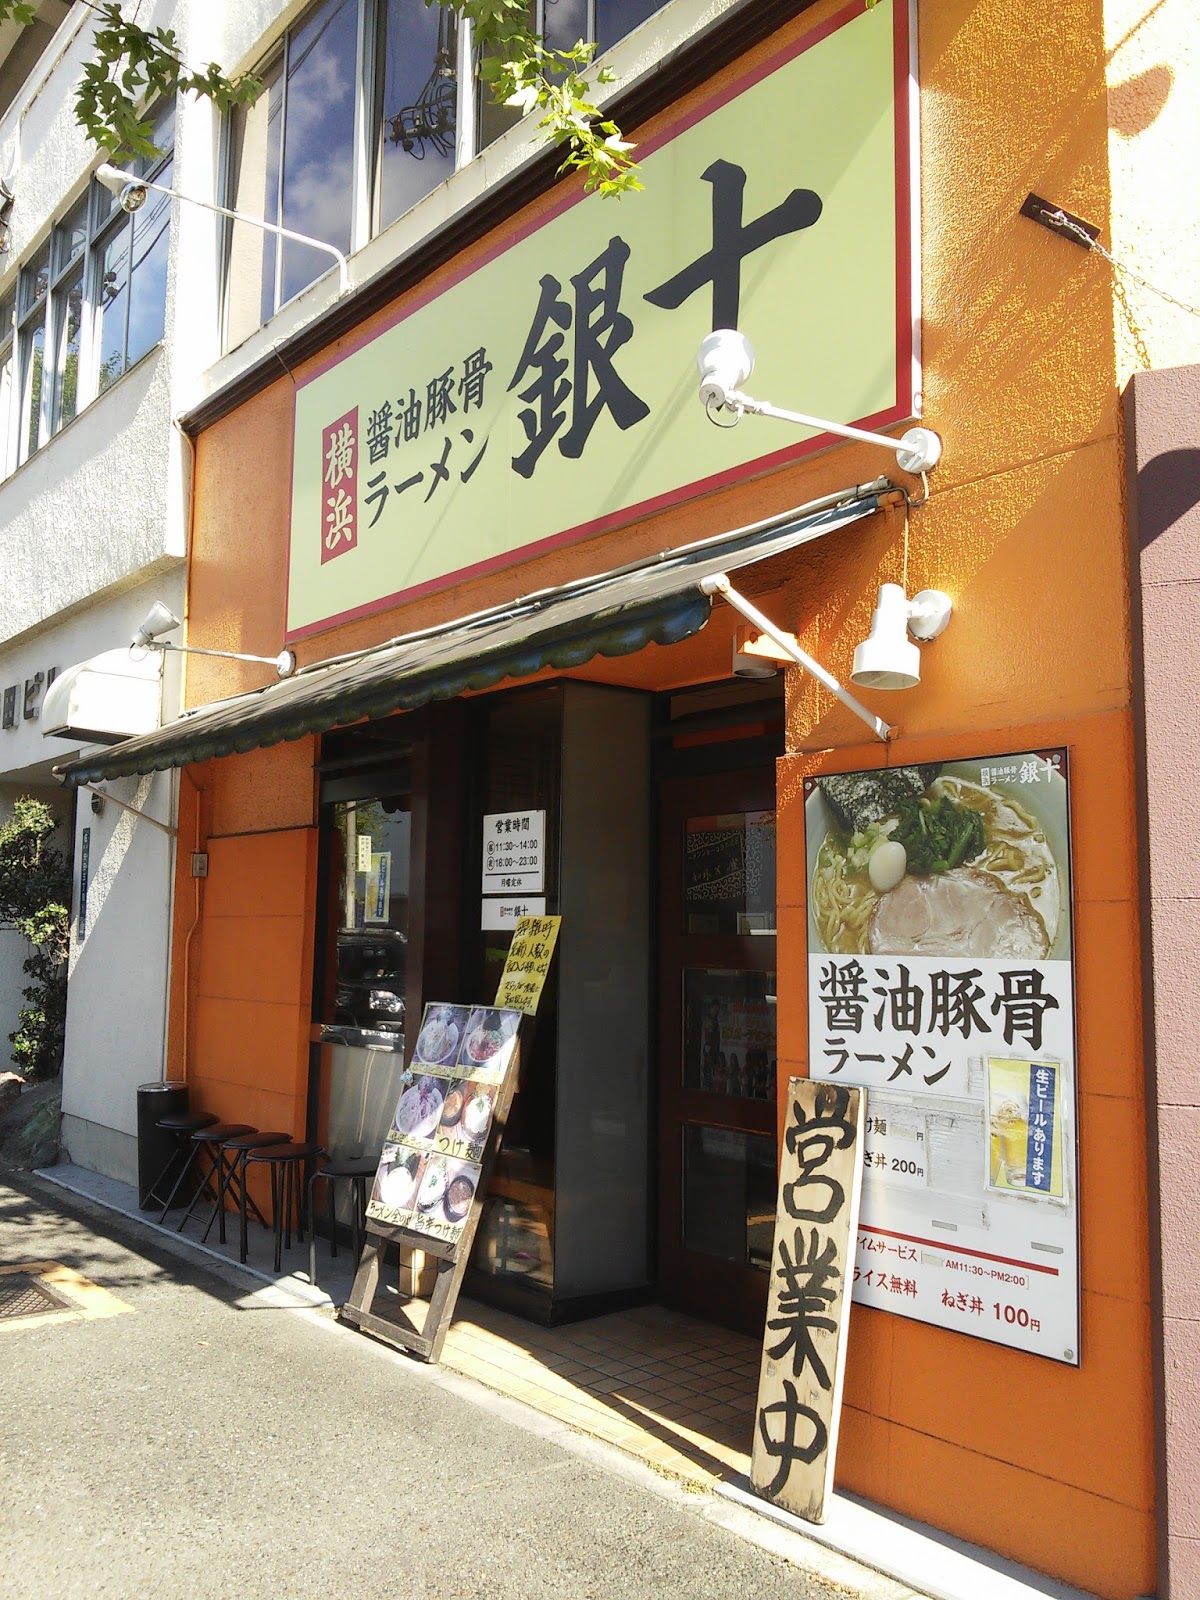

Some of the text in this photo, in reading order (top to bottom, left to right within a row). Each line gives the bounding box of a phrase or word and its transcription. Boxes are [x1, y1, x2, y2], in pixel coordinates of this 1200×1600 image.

[506, 158, 822, 479] 銀十
[366, 346, 493, 465] 醤油豚骨
[324, 422, 355, 550] 横浜
[364, 428, 489, 528] ラーメン
[991, 775, 1018, 785] ラーメン
[1018, 757, 1061, 784] 銀十
[495, 817, 530, 834] 営業時間
[818, 958, 1060, 1051] 醤油豚骨
[823, 1037, 951, 1086] ラーメン
[439, 1137, 482, 1159] つけ麺
[1032, 1069, 1050, 1186] 生ビールあります
[892, 1158, 924, 1177] 200円
[856, 1236, 918, 1263] イムサービス
[759, 1084, 857, 1499] 営業中
[941, 1288, 985, 1316] ねぎ丼
[993, 1302, 1041, 1333] 100円
